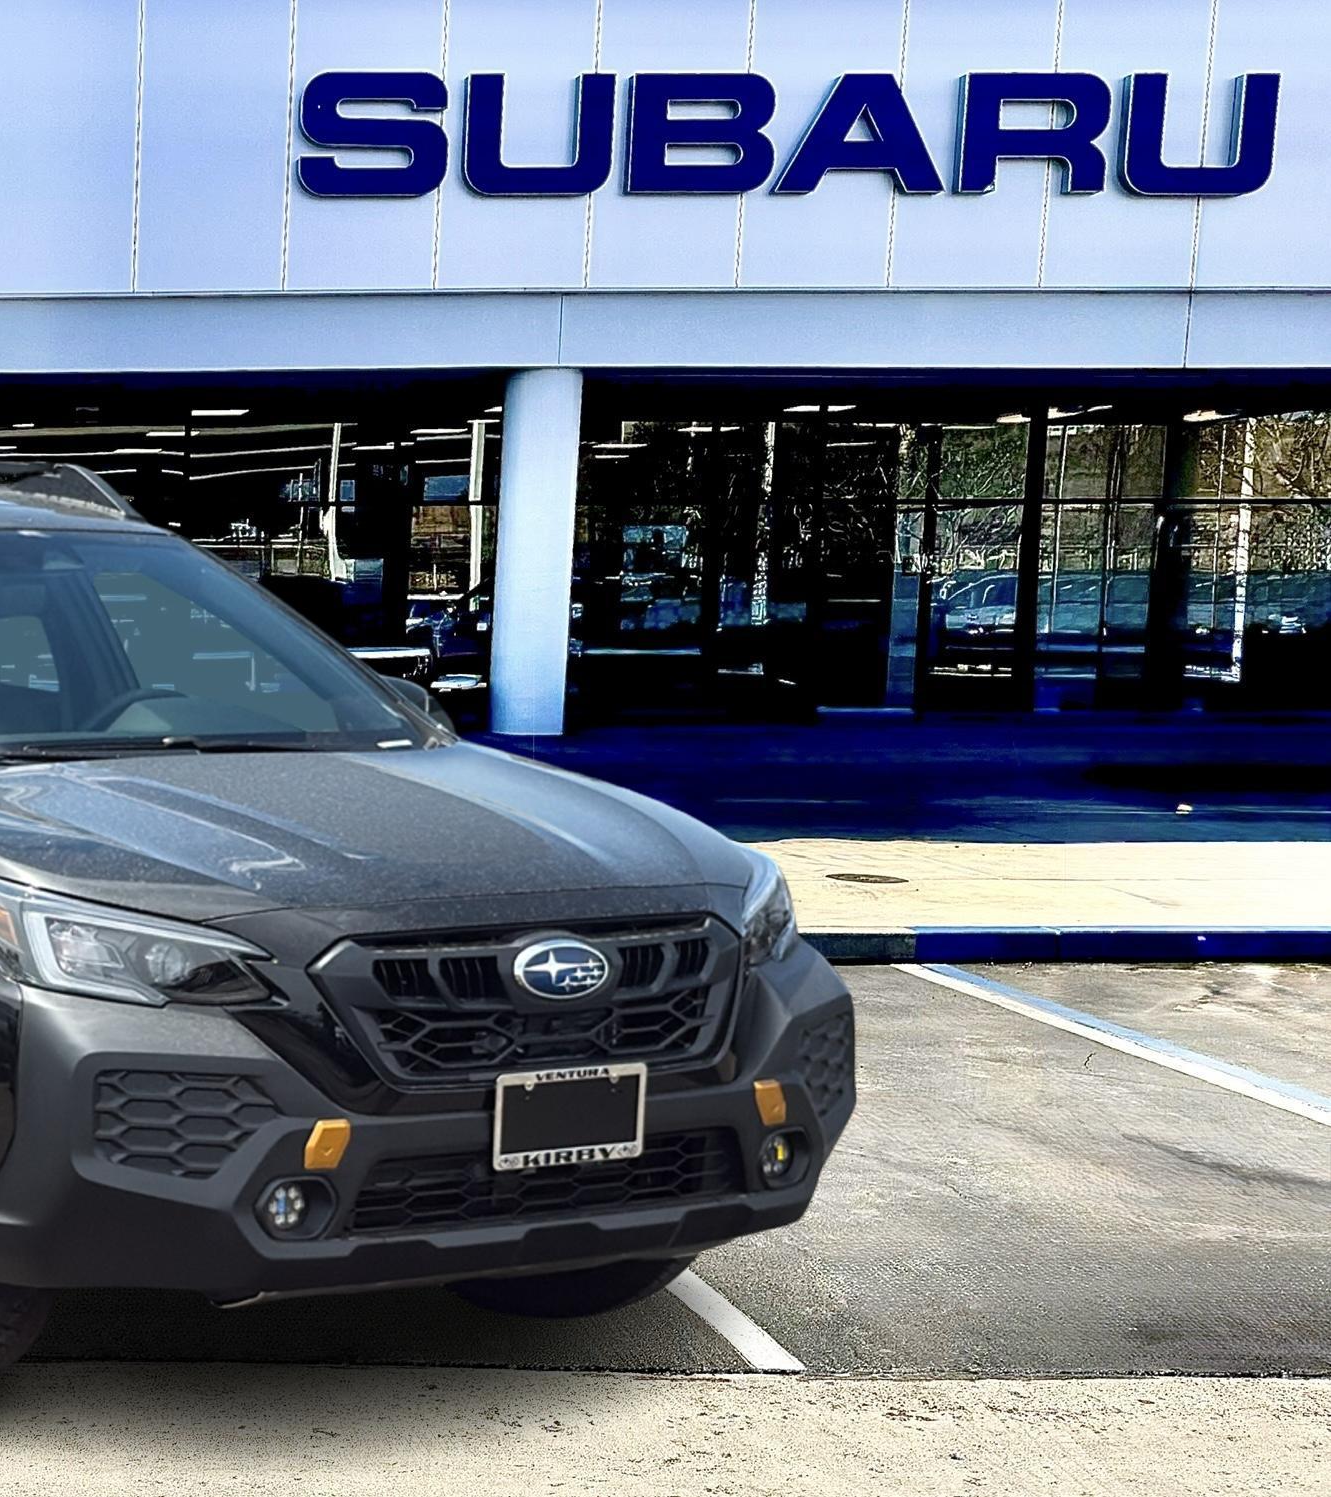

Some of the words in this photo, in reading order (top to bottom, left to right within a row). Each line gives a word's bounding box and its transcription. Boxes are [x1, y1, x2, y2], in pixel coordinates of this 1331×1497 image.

[297, 70, 1281, 198] SUBARU
[535, 1067, 610, 1082] VENTURA
[522, 1146, 616, 1167] KIRBY
